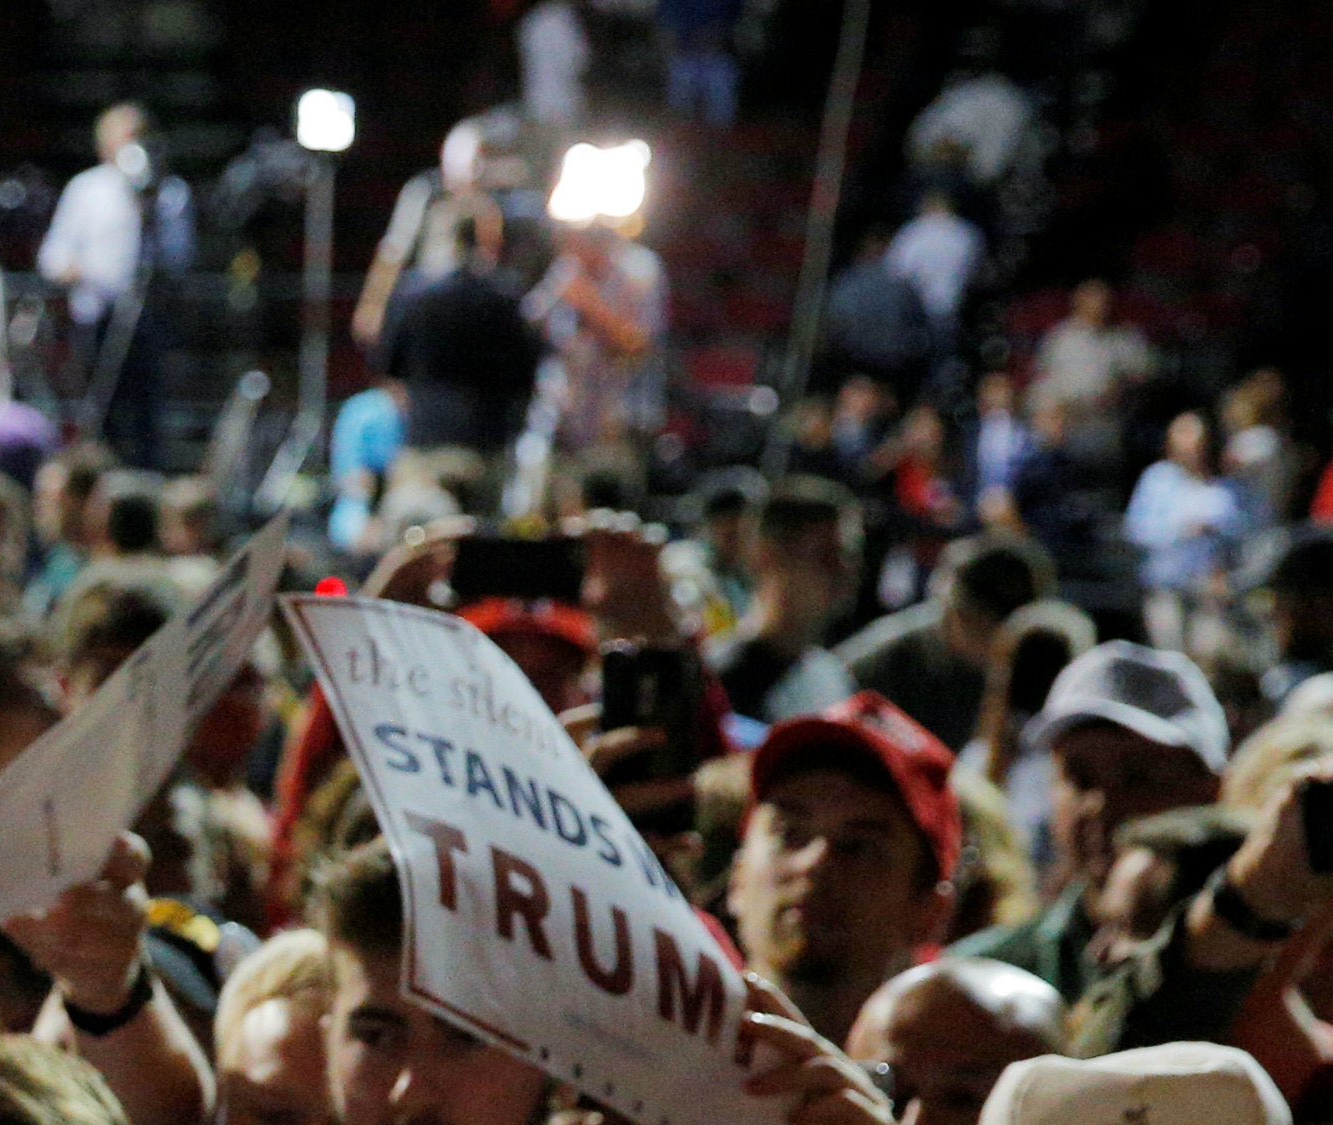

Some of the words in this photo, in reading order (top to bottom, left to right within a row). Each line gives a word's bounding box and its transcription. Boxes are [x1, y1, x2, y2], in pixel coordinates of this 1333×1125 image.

[345, 637, 434, 692] the
[373, 723, 623, 869] STANDS
[403, 810, 753, 1068] TRUM
